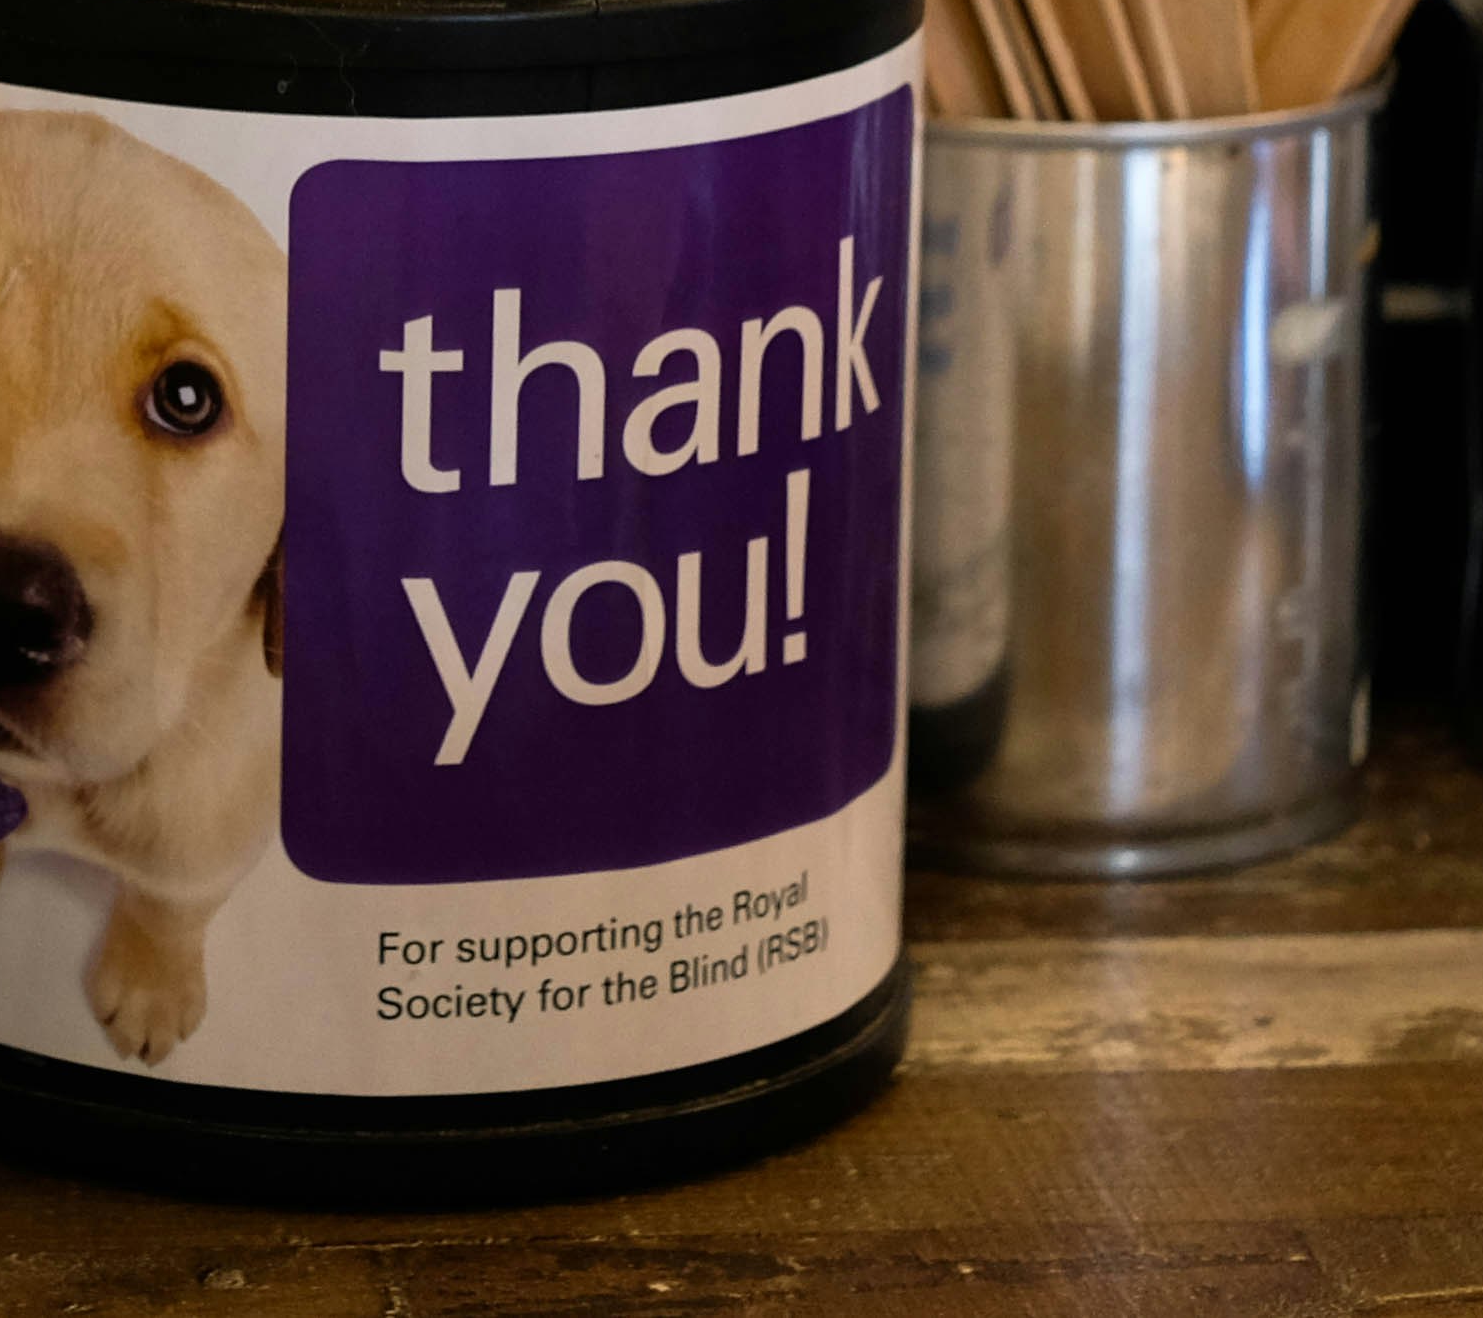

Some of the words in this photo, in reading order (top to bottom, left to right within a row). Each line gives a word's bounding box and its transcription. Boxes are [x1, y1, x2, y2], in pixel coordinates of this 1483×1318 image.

[379, 235, 882, 493] thank
[400, 468, 811, 766] you!
[377, 985, 526, 1023] Society
[539, 978, 591, 1013] for
[602, 971, 658, 1006] the
[669, 946, 748, 995] Blind
[757, 915, 830, 975] (RSB)
[378, 931, 443, 965] For
[456, 916, 663, 969] supporting
[673, 903, 723, 940] the
[733, 870, 808, 925] Royal
